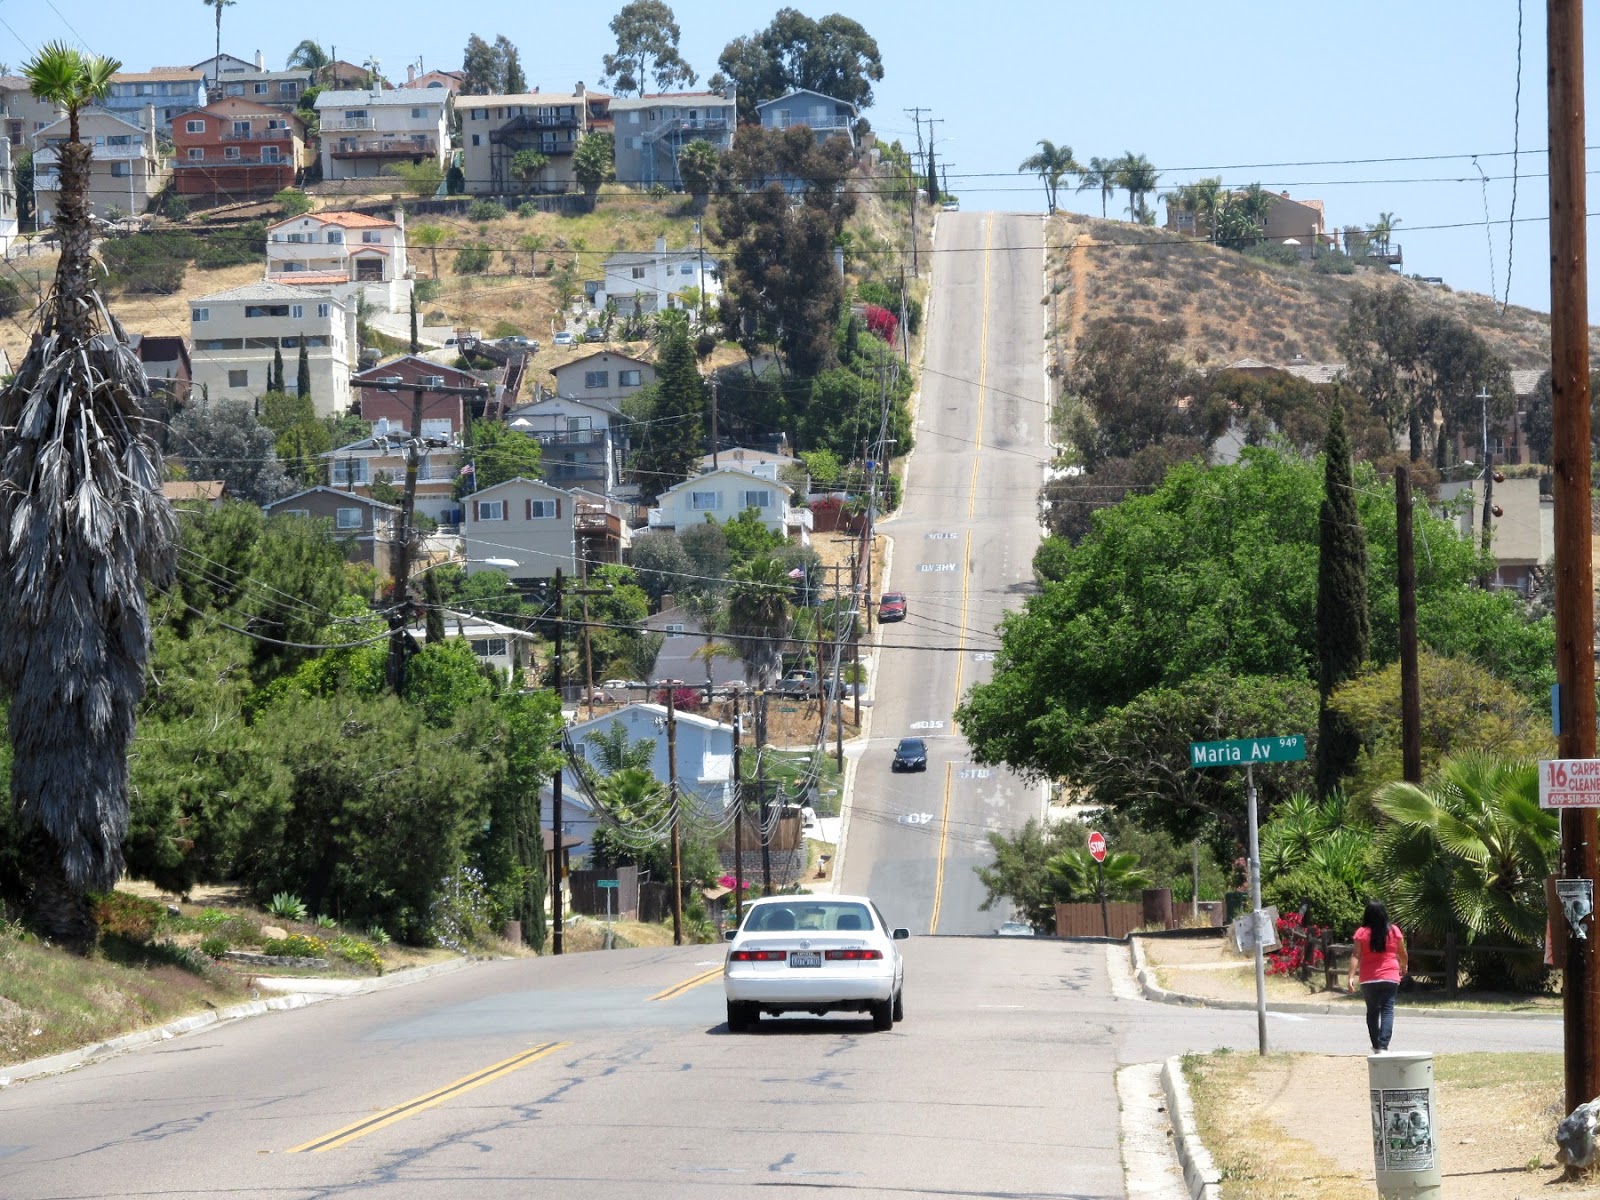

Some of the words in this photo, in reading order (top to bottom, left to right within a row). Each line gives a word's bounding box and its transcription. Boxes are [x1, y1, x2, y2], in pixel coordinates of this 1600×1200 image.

[921, 563, 956, 571] AHEAD
[910, 720, 944, 729] STOP
[1194, 744, 1241, 763] Maria
[1251, 742, 1271, 759] Av
[1280, 738, 1297, 747] 949
[1571, 762, 1600, 775] CARPE
[1090, 841, 1105, 853] STOP
